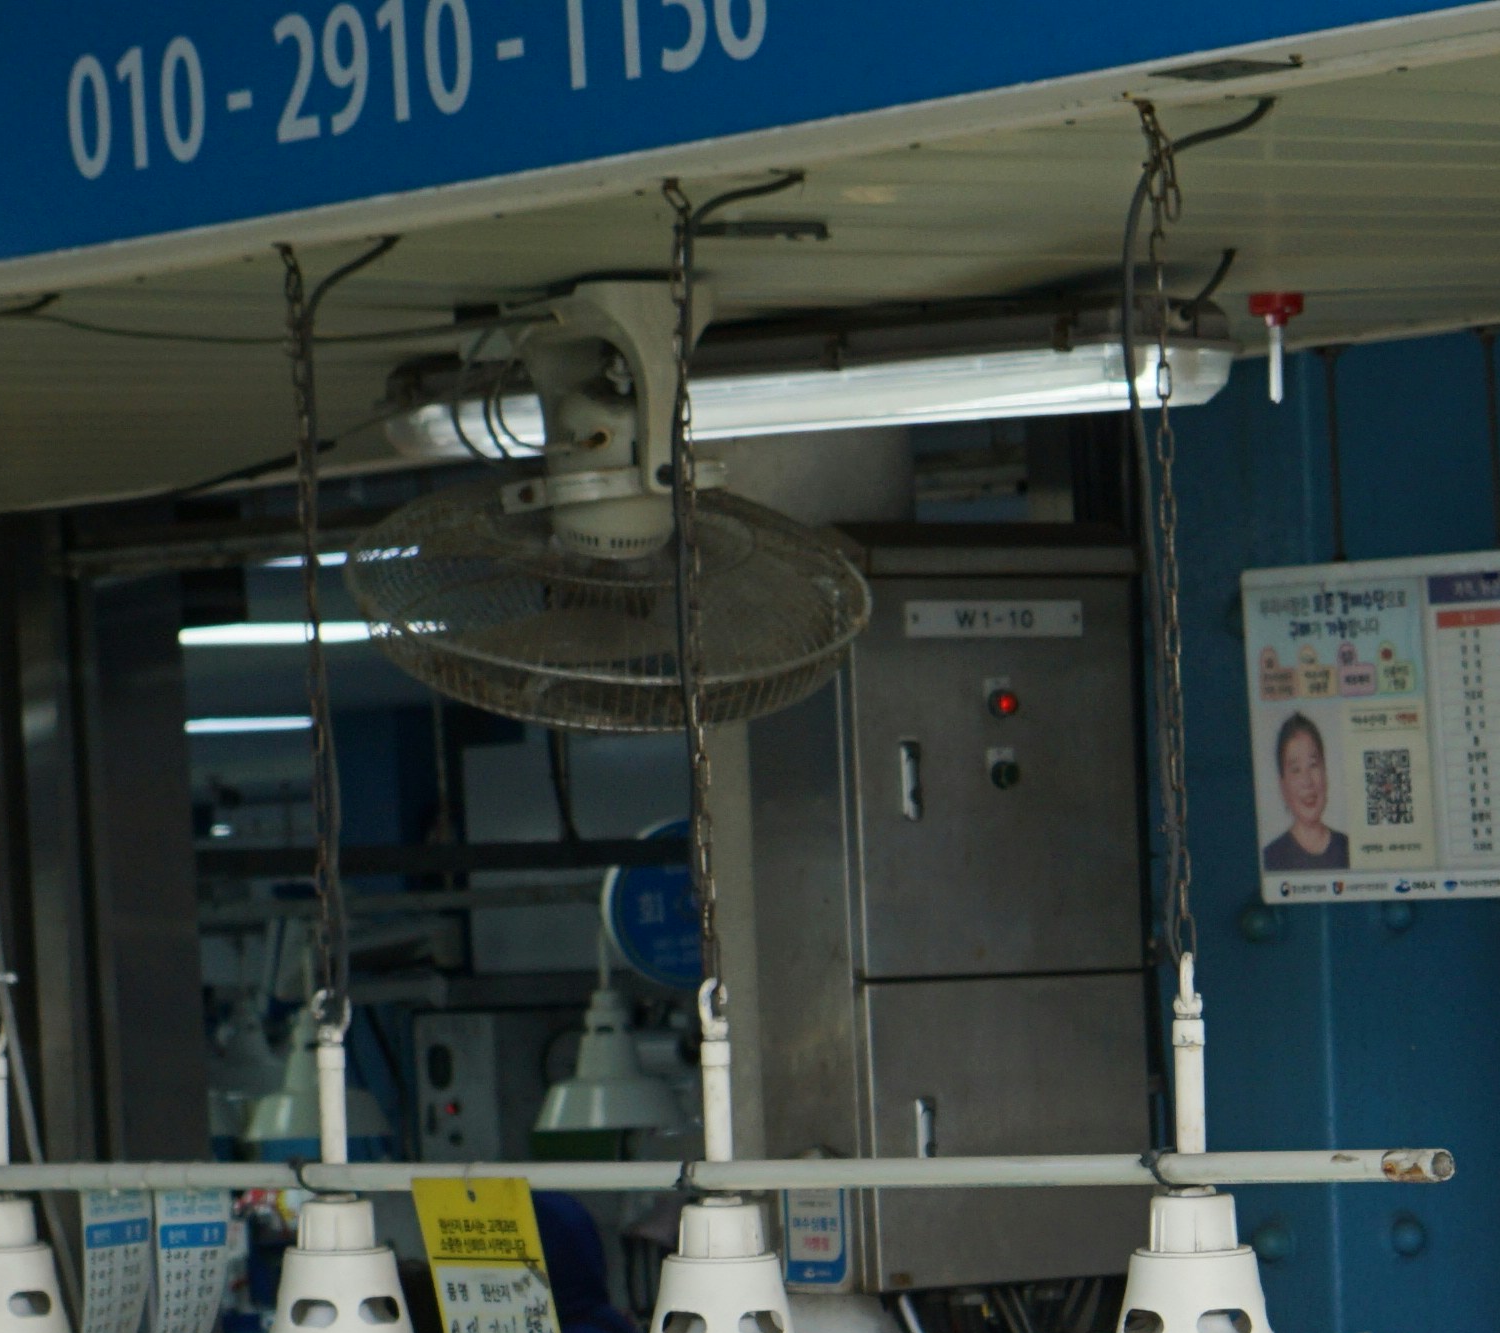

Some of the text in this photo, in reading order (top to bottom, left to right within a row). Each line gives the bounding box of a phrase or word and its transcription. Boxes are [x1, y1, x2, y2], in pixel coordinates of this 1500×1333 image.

[66, 36, 206, 180] 010
[272, 0, 474, 144] 2910
[1313, 591, 1335, 616] 모든
[955, 608, 1035, 629] W1-10
